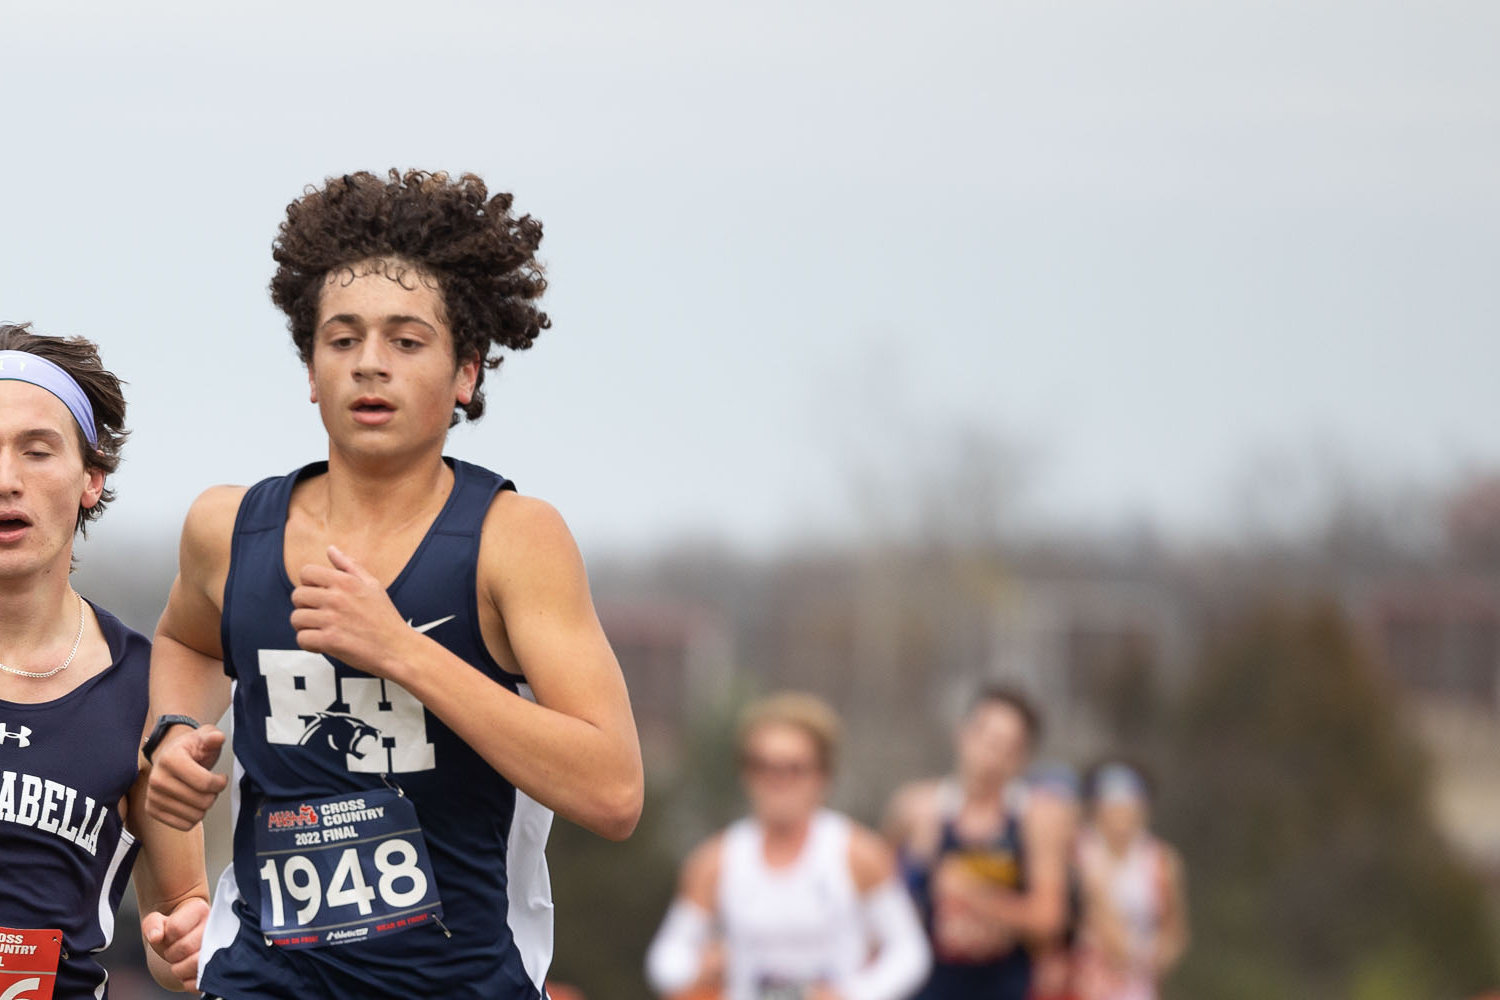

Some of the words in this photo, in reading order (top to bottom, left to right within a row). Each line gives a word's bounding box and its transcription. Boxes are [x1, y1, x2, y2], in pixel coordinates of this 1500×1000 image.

[320, 799, 366, 815] CROSS
[322, 807, 385, 826] COUNTRY
[295, 832, 321, 845] 2022
[322, 825, 359, 842] FINAL
[260, 839, 428, 927] 1948
